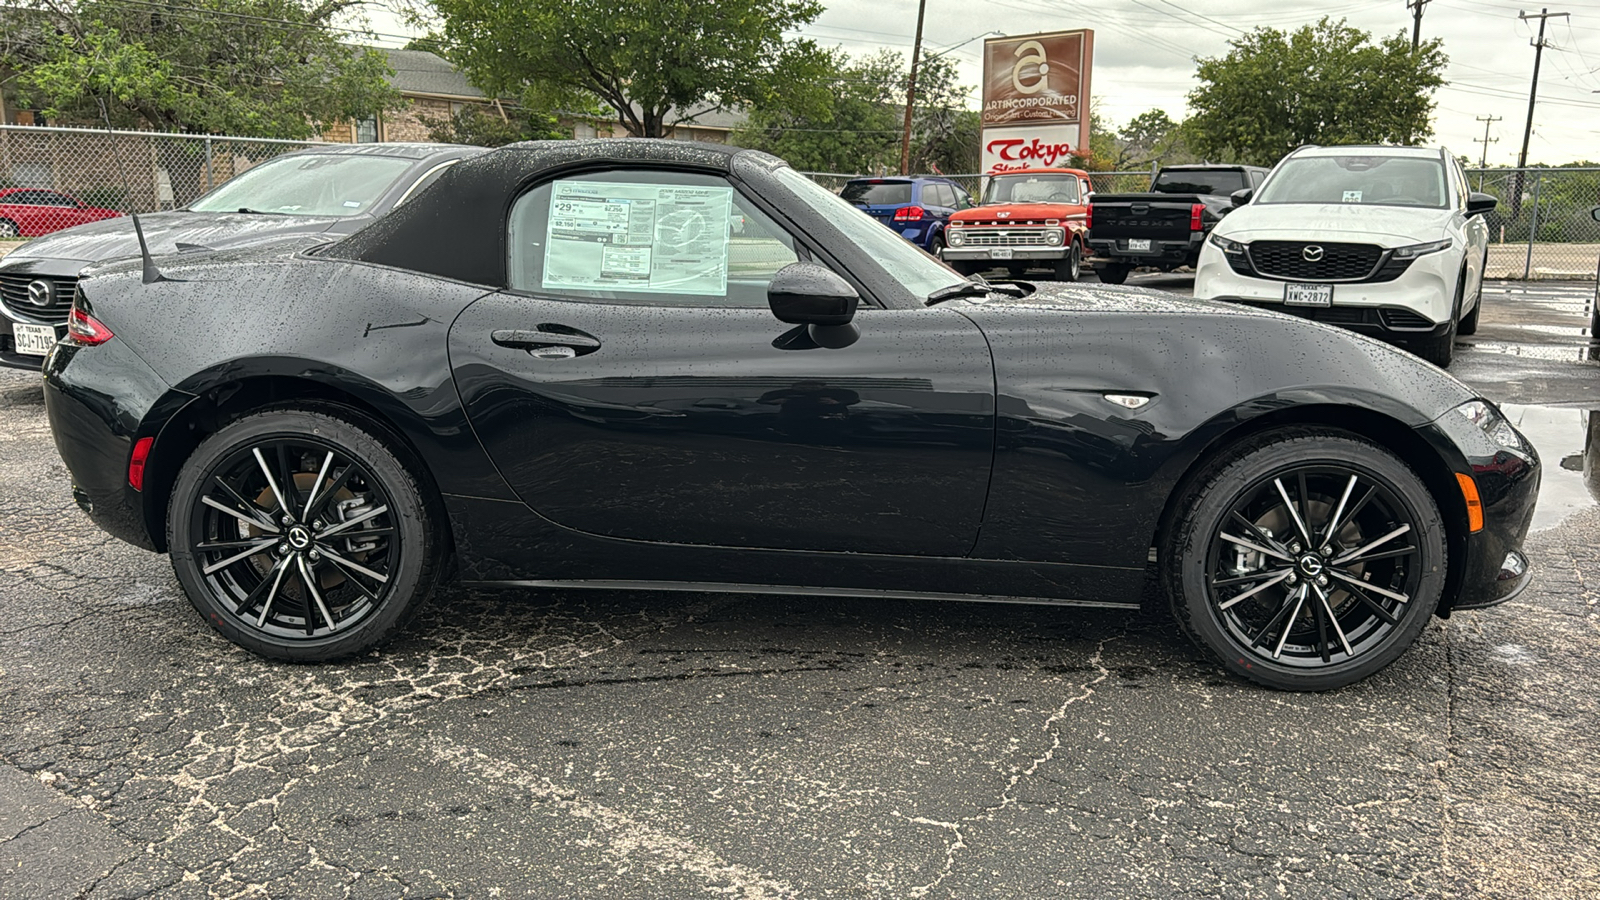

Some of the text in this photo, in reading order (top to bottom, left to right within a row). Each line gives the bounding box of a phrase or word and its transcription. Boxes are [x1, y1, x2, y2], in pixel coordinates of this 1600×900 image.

[984, 112, 1010, 121] Origa
[986, 138, 1070, 167] Tokyo
[558, 203, 572, 212] 29
